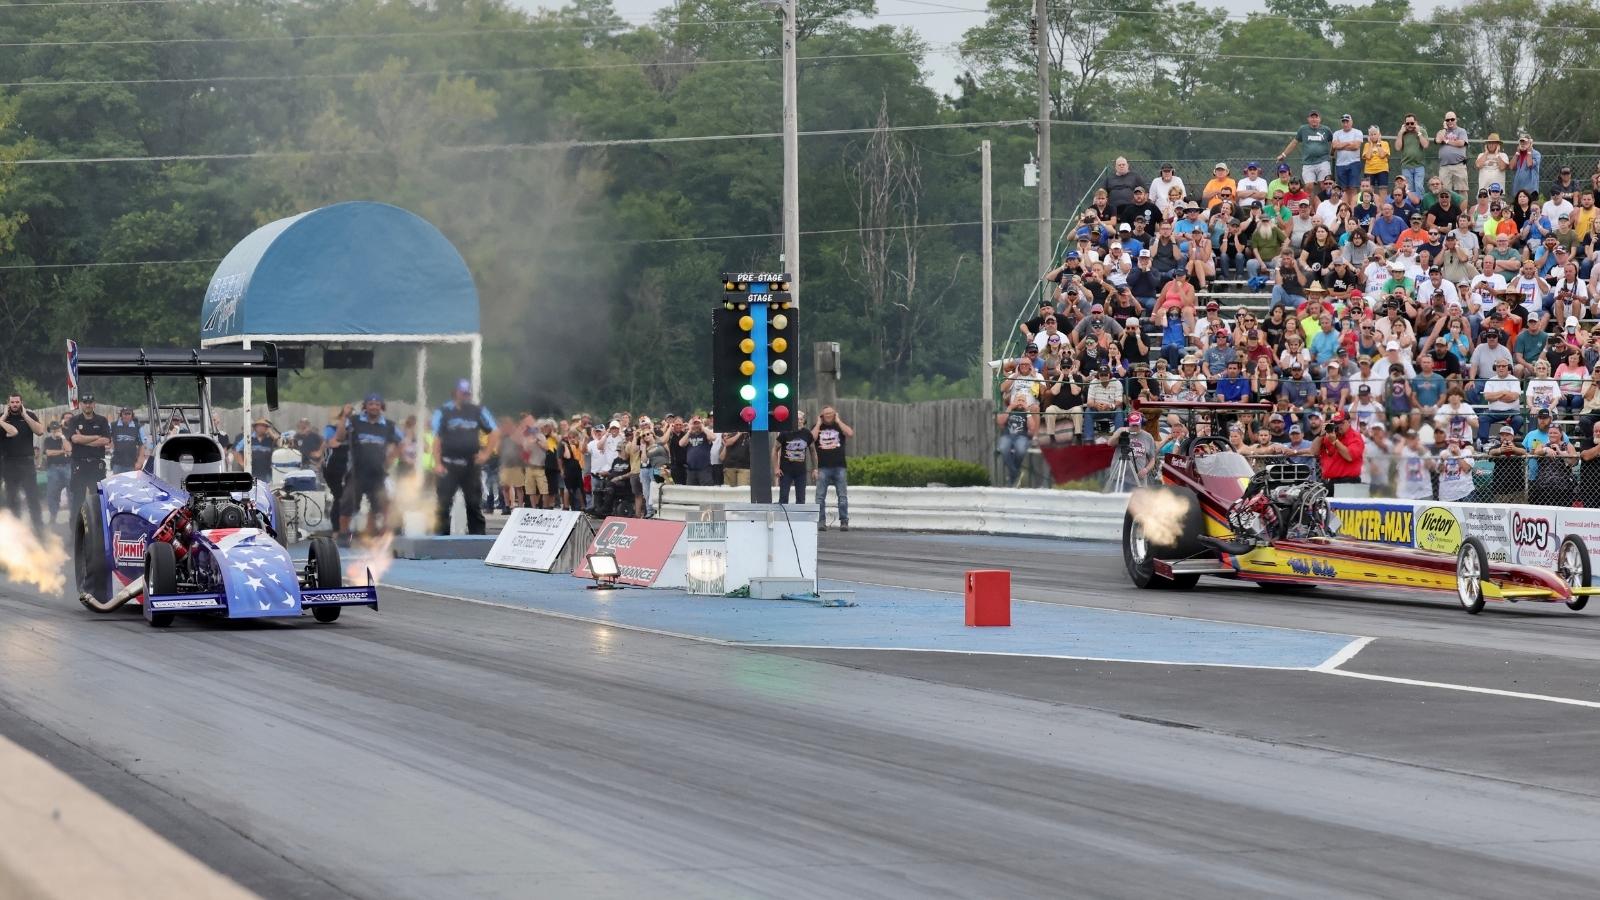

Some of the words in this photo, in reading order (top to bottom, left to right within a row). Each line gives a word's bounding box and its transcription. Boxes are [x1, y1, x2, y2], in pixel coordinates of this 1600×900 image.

[737, 274, 783, 282] PRE-STAGE
[748, 294, 773, 302] STAGE
[594, 521, 638, 554] QUICK
[1421, 513, 1455, 536] Victory
[1512, 511, 1549, 551] CADY
[113, 531, 147, 568] SUMMIT
